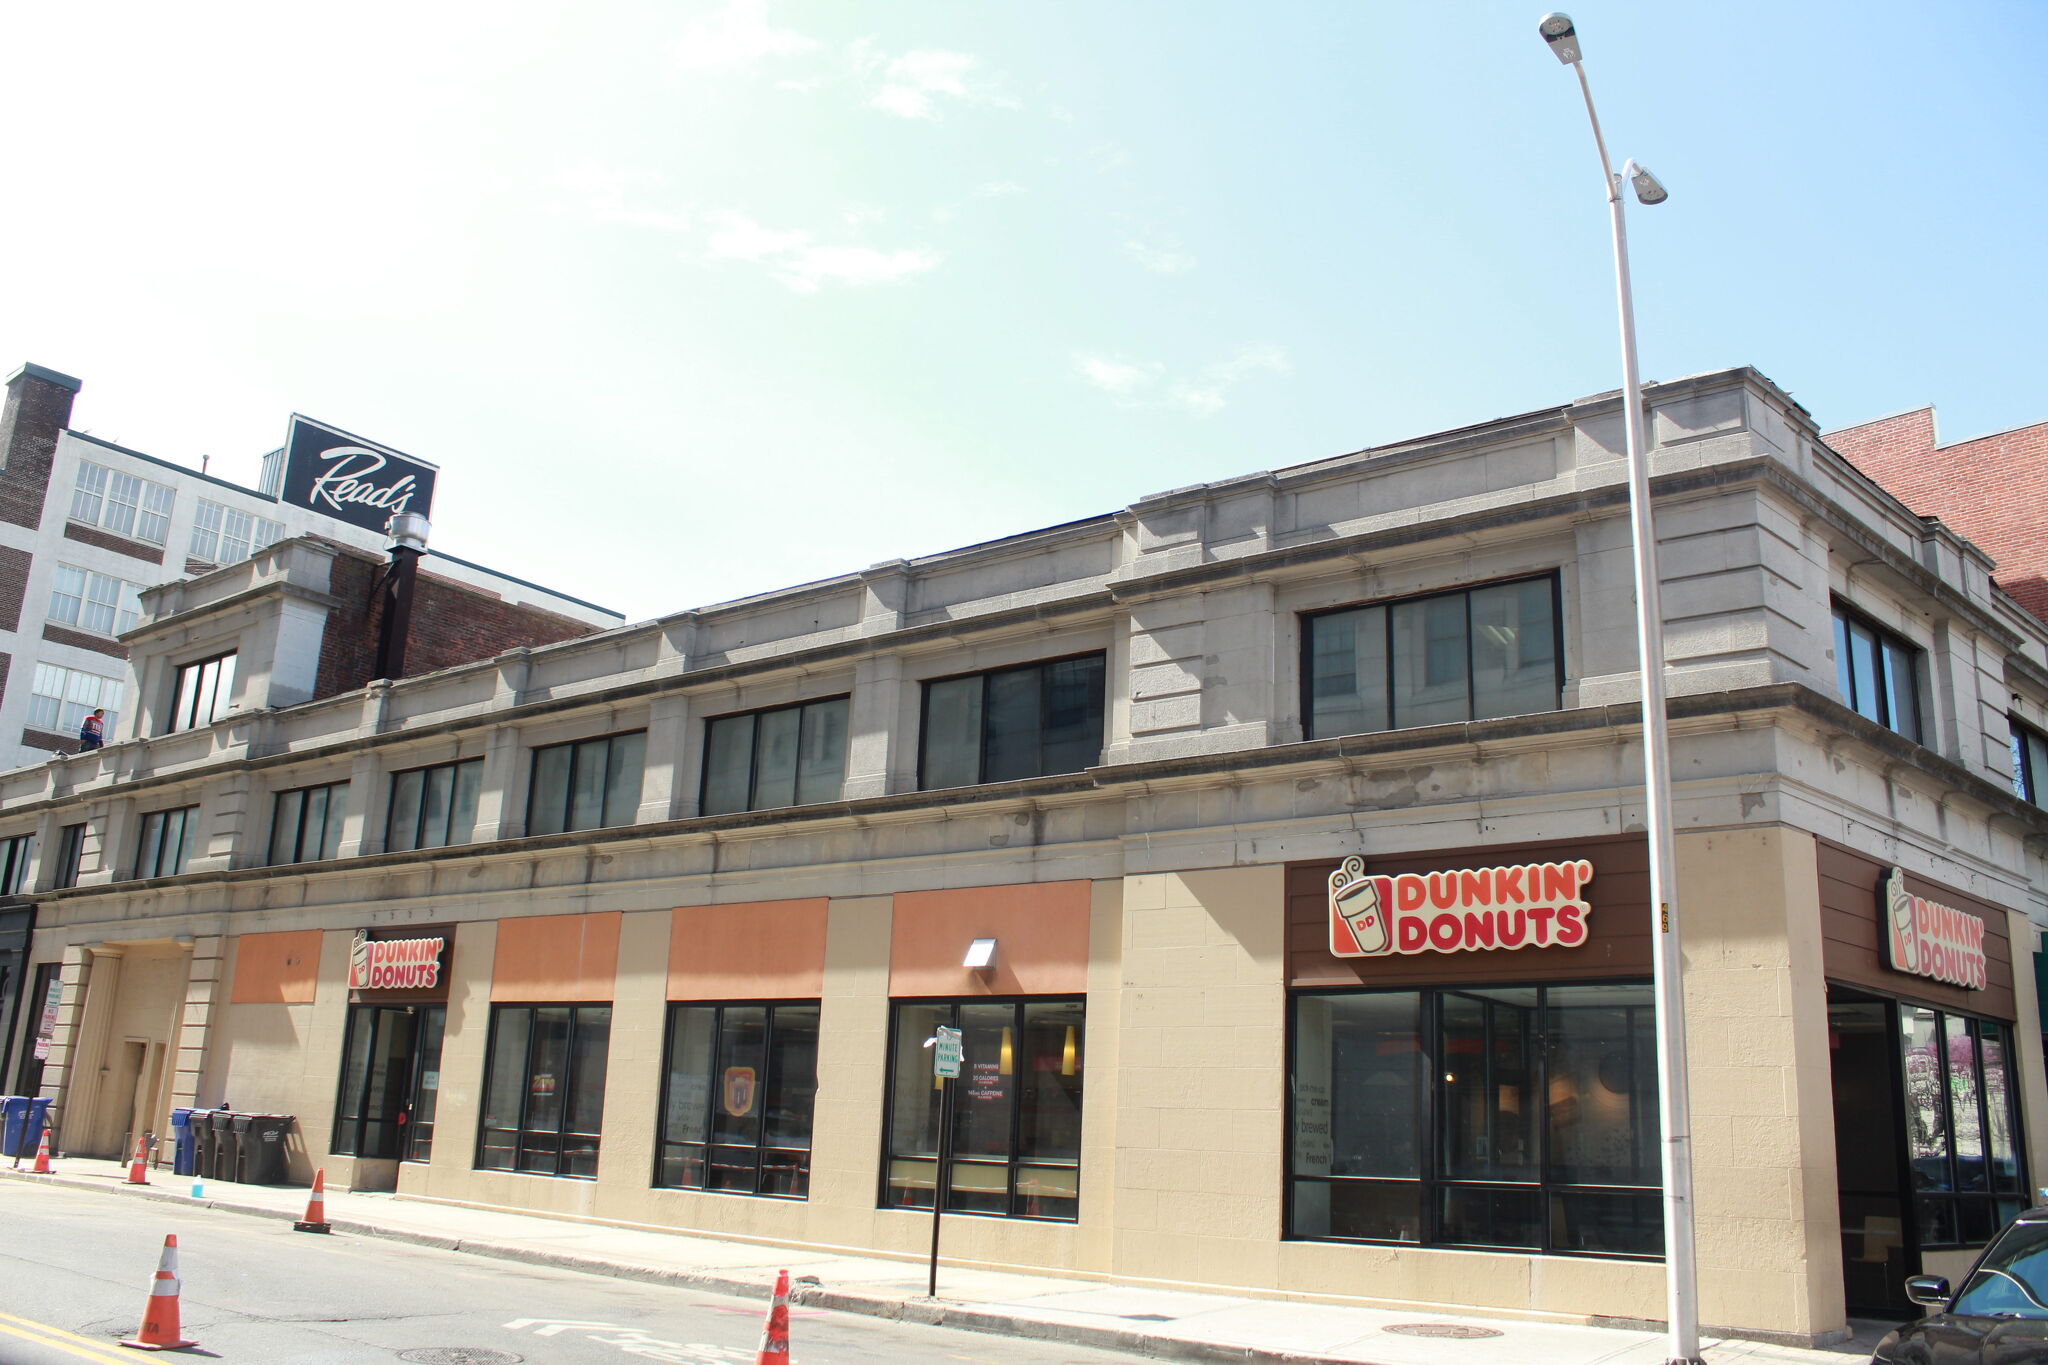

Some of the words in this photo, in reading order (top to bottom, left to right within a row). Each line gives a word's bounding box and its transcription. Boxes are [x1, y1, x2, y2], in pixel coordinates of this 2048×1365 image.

[310, 446, 417, 513] Read's
[1397, 863, 1589, 911] DUNKIN'
[1356, 915, 1375, 931] DD
[1398, 904, 1583, 951] DONUTS
[1918, 899, 1985, 951] DUNKIN'
[374, 939, 443, 963] DUNKIN'
[371, 963, 436, 987] DONUTS
[1919, 938, 1986, 989] DONUTS
[937, 1053, 958, 1063] PARKING
[938, 1043, 958, 1053] MINUTE
[1301, 1119, 1328, 1135] brewed
[1306, 1152, 1328, 1166] French
